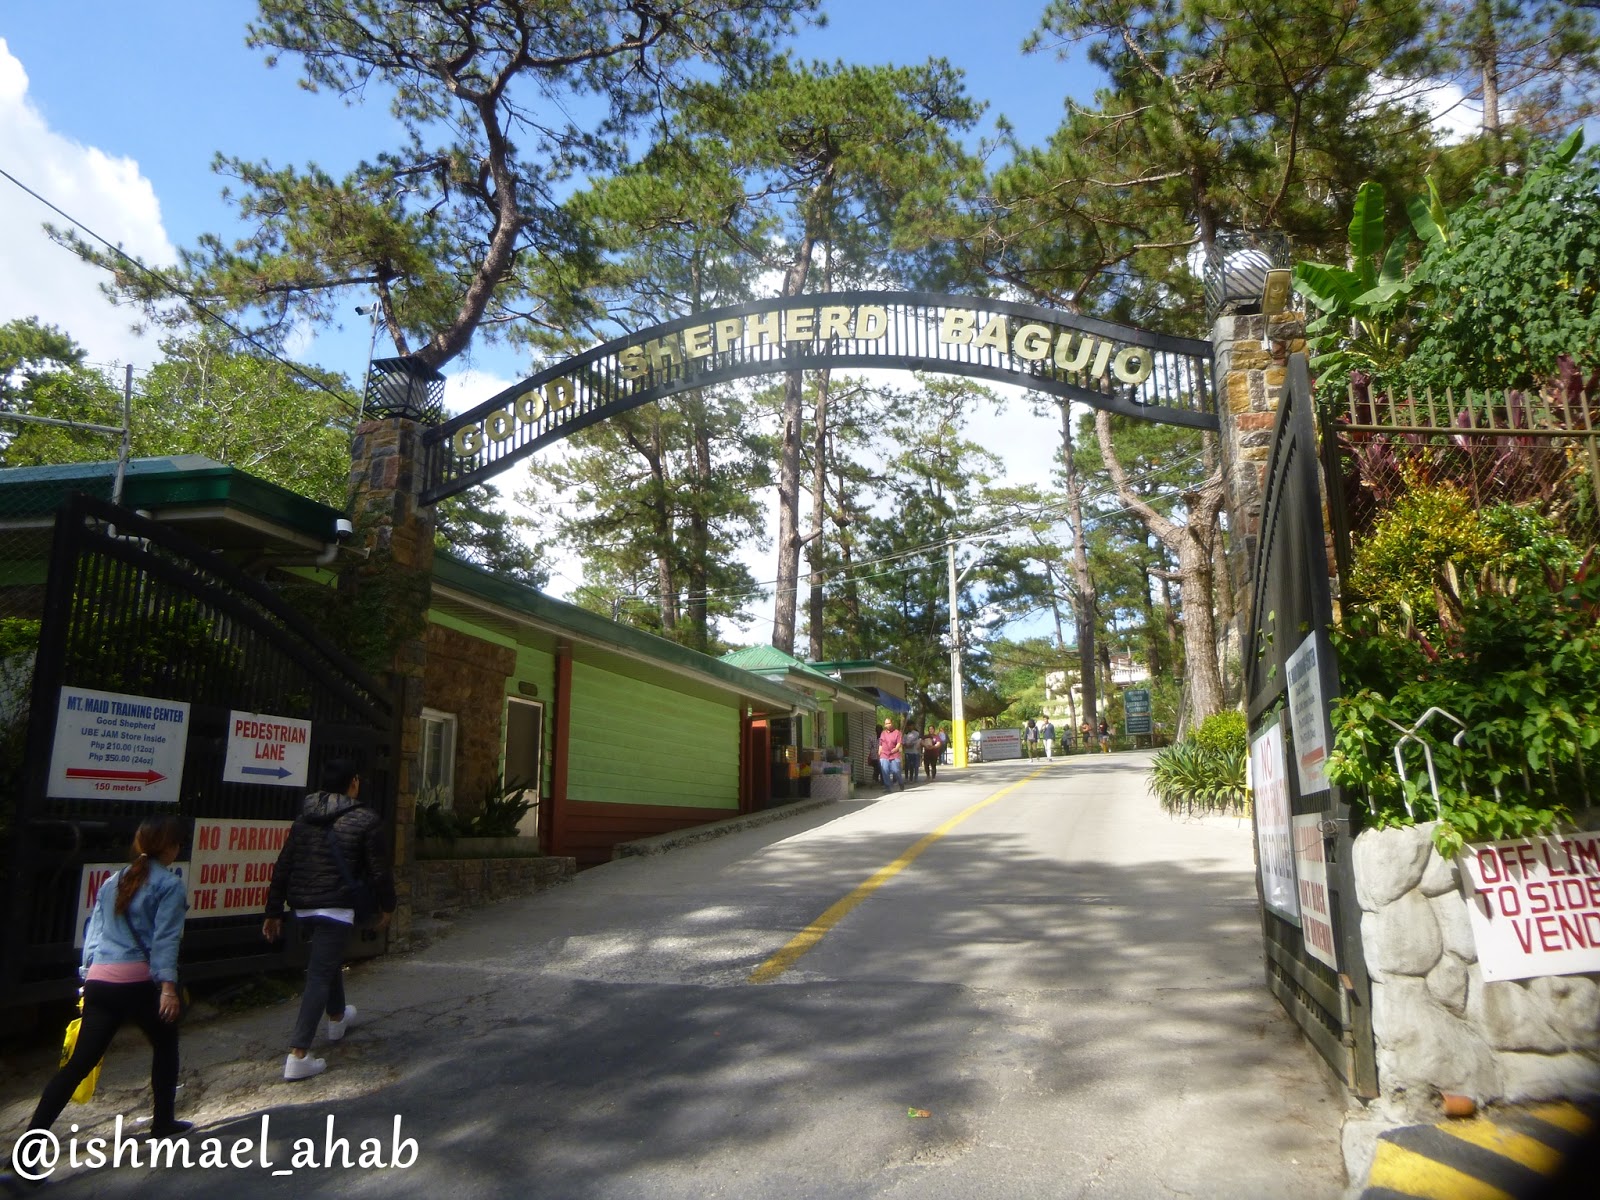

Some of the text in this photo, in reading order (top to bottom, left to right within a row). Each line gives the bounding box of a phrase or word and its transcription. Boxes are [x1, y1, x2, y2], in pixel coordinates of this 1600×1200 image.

[453, 305, 1153, 457] GOOD SHEPHERD BAGUIO
[67, 696, 184, 723] MT. MAID TRAINING CENTER
[96, 716, 156, 730] Good Shepherd
[235, 719, 307, 744] PEDESTRIAN
[81, 727, 167, 744] UBE JAM Store Inside
[88, 752, 103, 762] Php
[90, 740, 155, 754] Php 210.00 (12oz)
[255, 741, 286, 761] LANE
[95, 783, 142, 792] 150 meters
[198, 825, 222, 851] NO
[1477, 838, 1600, 885] OFF LIM
[200, 863, 239, 885] DON'T
[194, 889, 218, 911] THE
[1474, 876, 1600, 920] TO SIDE
[1511, 911, 1600, 955] VEND
